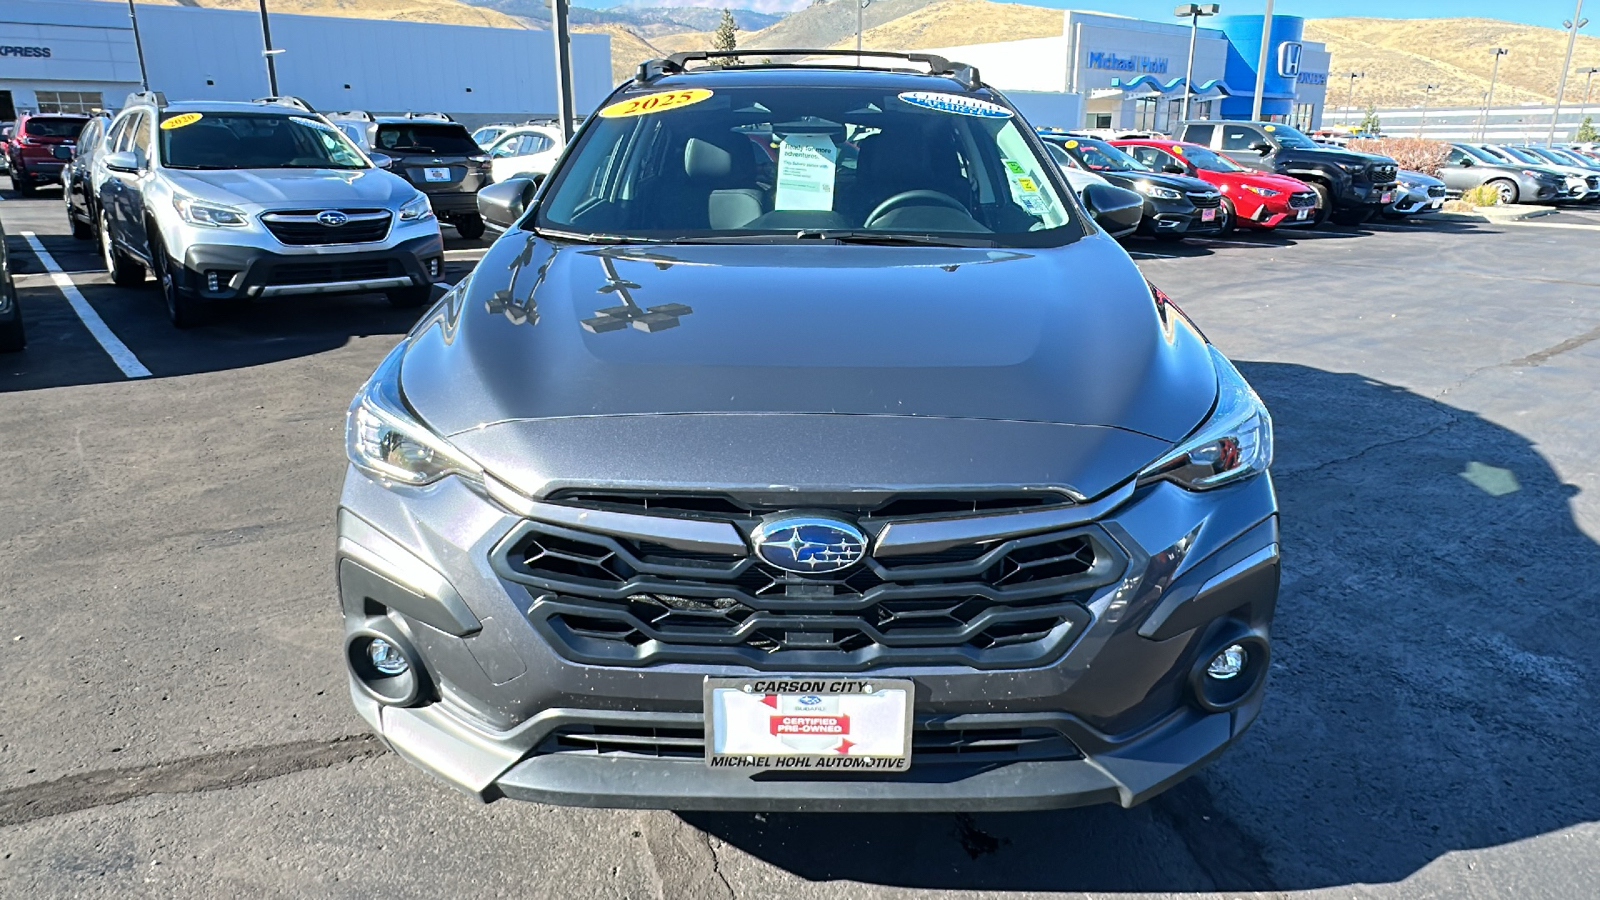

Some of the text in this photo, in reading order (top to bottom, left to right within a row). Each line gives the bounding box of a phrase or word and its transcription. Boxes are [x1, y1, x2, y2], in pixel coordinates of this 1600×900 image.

[1087, 51, 1168, 74] Michael Hohl
[1296, 71, 1327, 85] ONDA
[623, 91, 694, 115] 2025
[168, 114, 195, 128] 2020
[785, 143, 803, 152] Ready
[754, 681, 868, 693] CARSON CITY
[782, 717, 837, 726] CERTIFIED
[777, 725, 842, 733] PRE-OWNED
[710, 756, 906, 769] MICHAEL HOHL AUTOMOTIVE
